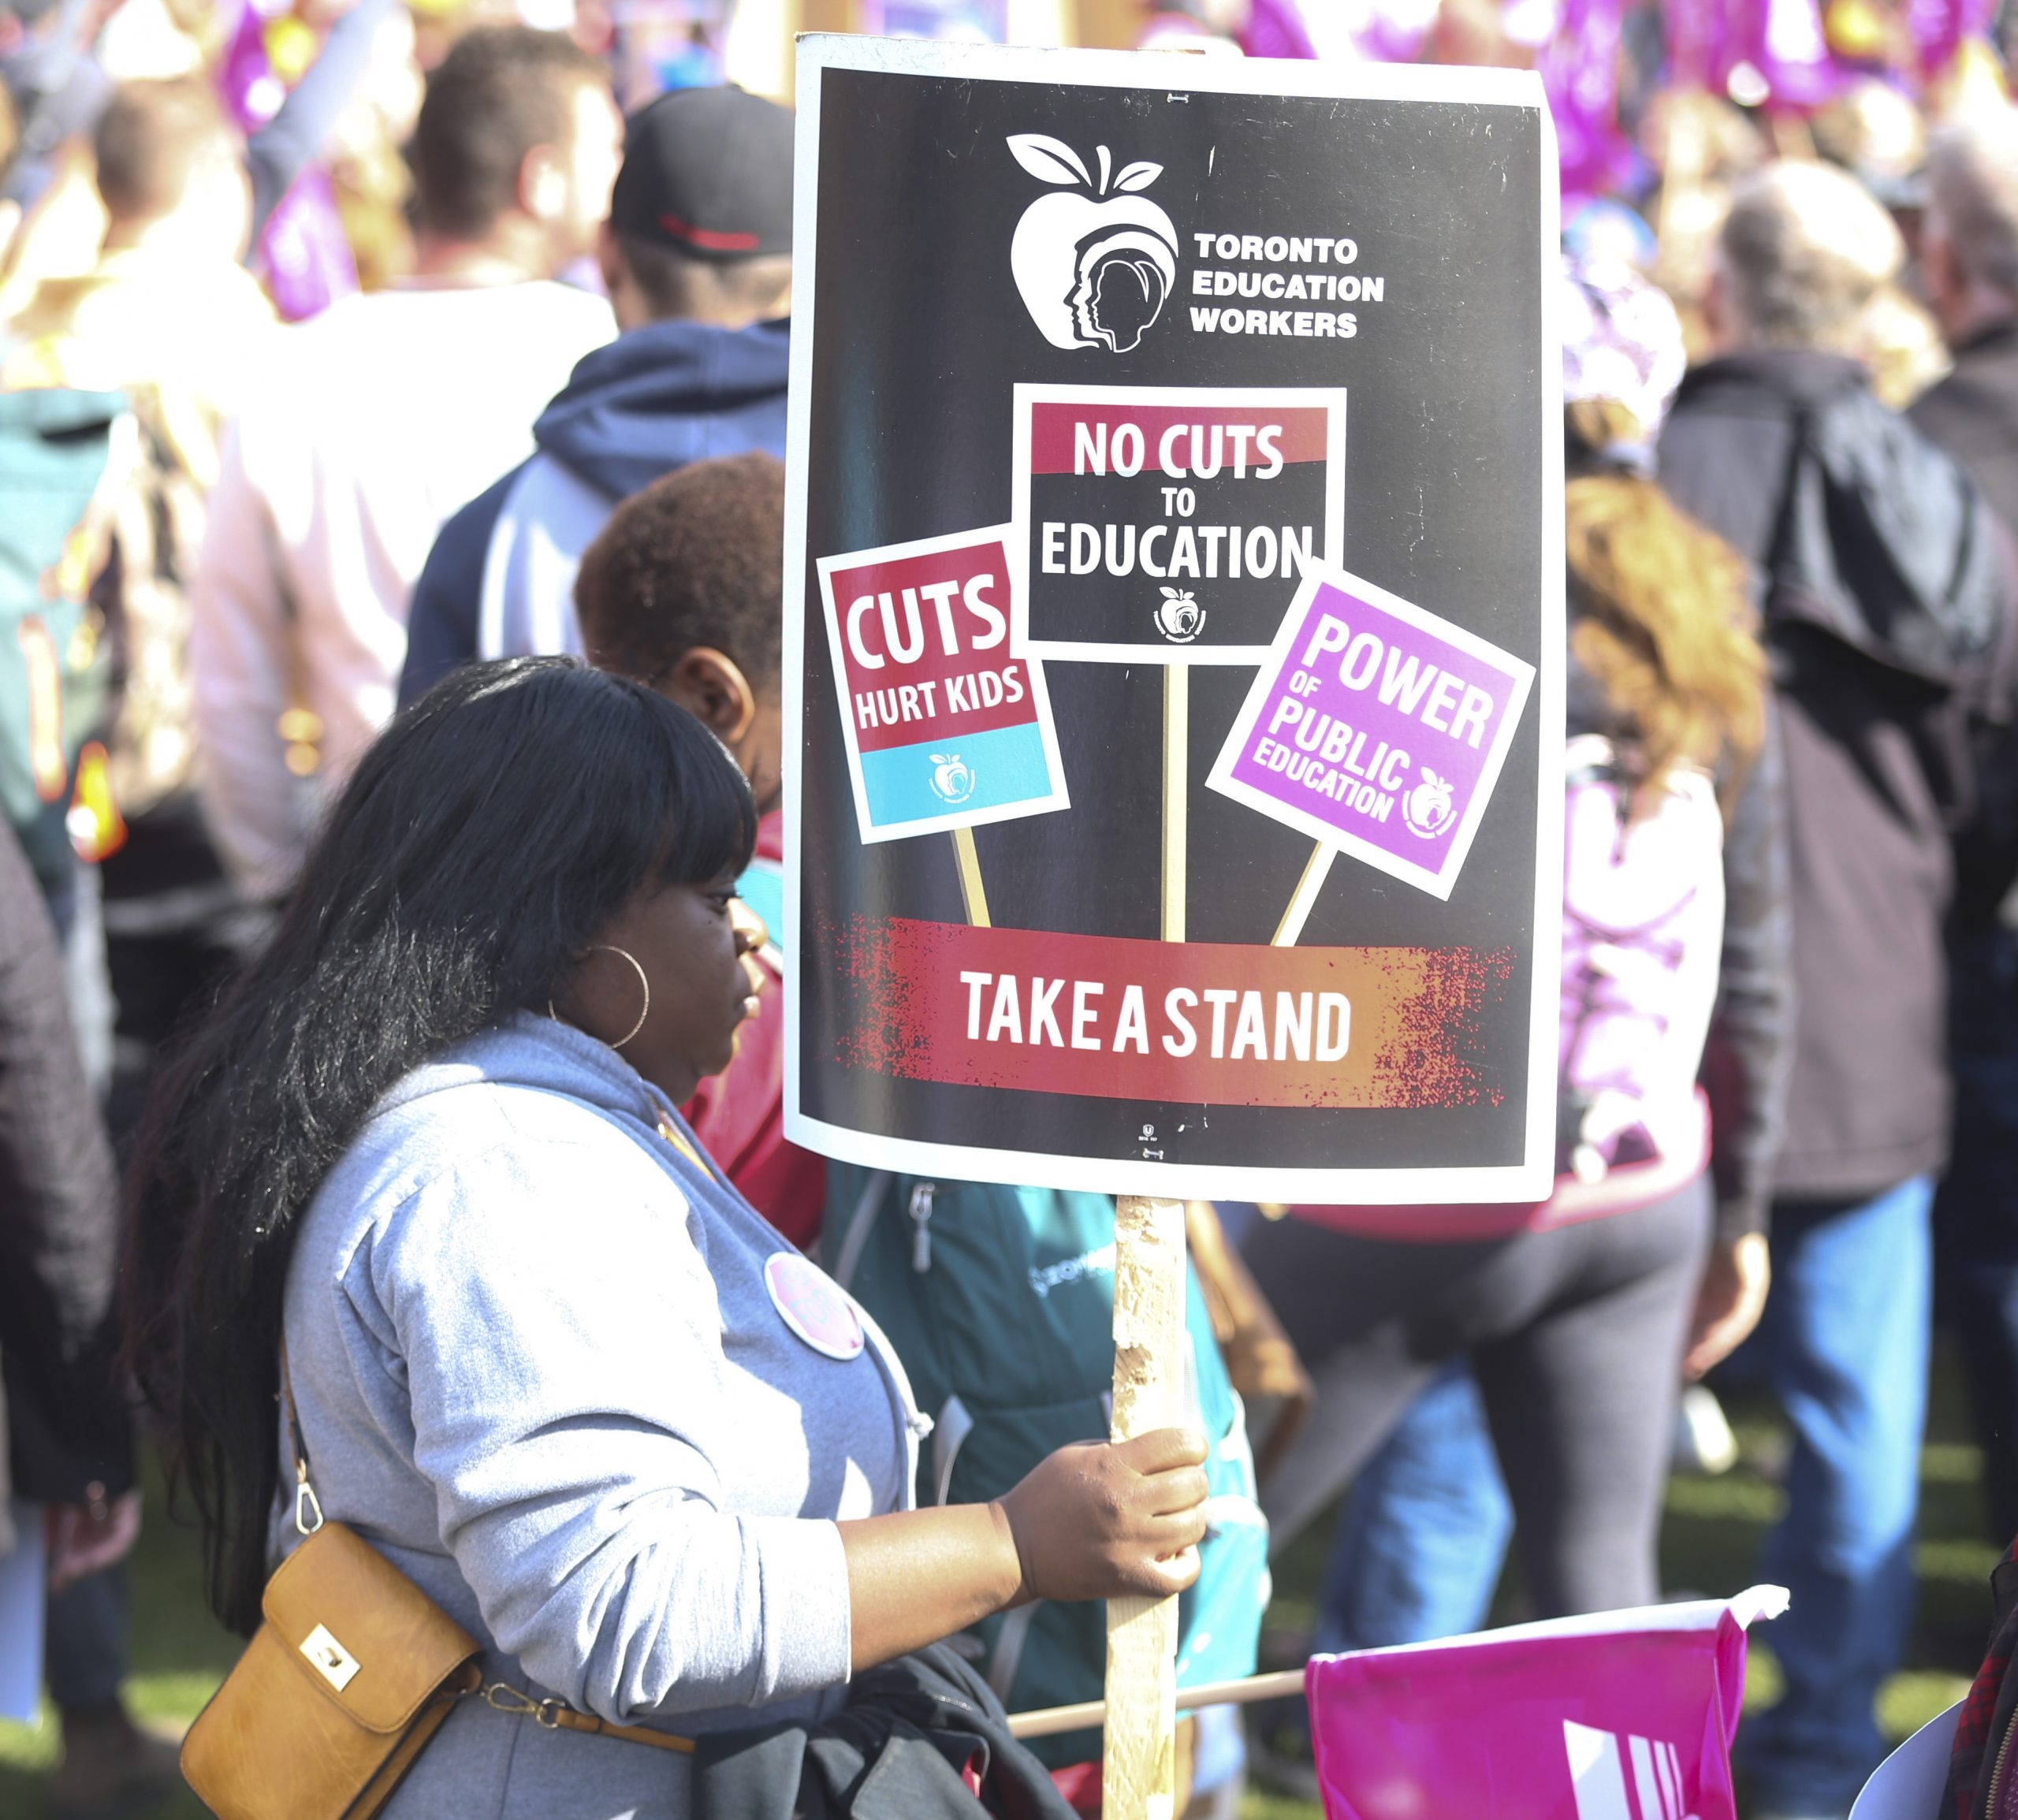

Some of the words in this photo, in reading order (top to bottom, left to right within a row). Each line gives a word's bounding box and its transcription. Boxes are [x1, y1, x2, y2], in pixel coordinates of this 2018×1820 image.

[1194, 233, 1358, 264] TORONTO
[1192, 271, 1384, 302] EDUCATION
[1189, 307, 1357, 338] WORKERS
[1074, 422, 1145, 476] NO
[1159, 424, 1284, 480] CUTS
[1161, 486, 1196, 517] TO
[1041, 521, 1312, 579] EDUCATION
[846, 573, 1007, 669] CUTS
[855, 681, 936, 729] HURT
[944, 665, 1024, 714] KIDS
[1289, 669, 1322, 698] OF
[1301, 612, 1494, 750] POWER
[1268, 695, 1411, 791] PUBLIC
[1253, 736, 1394, 823] EDUCATION
[960, 970, 1104, 1051] TAKE
[1111, 984, 1149, 1055] A
[1162, 987, 1351, 1062] STAND
